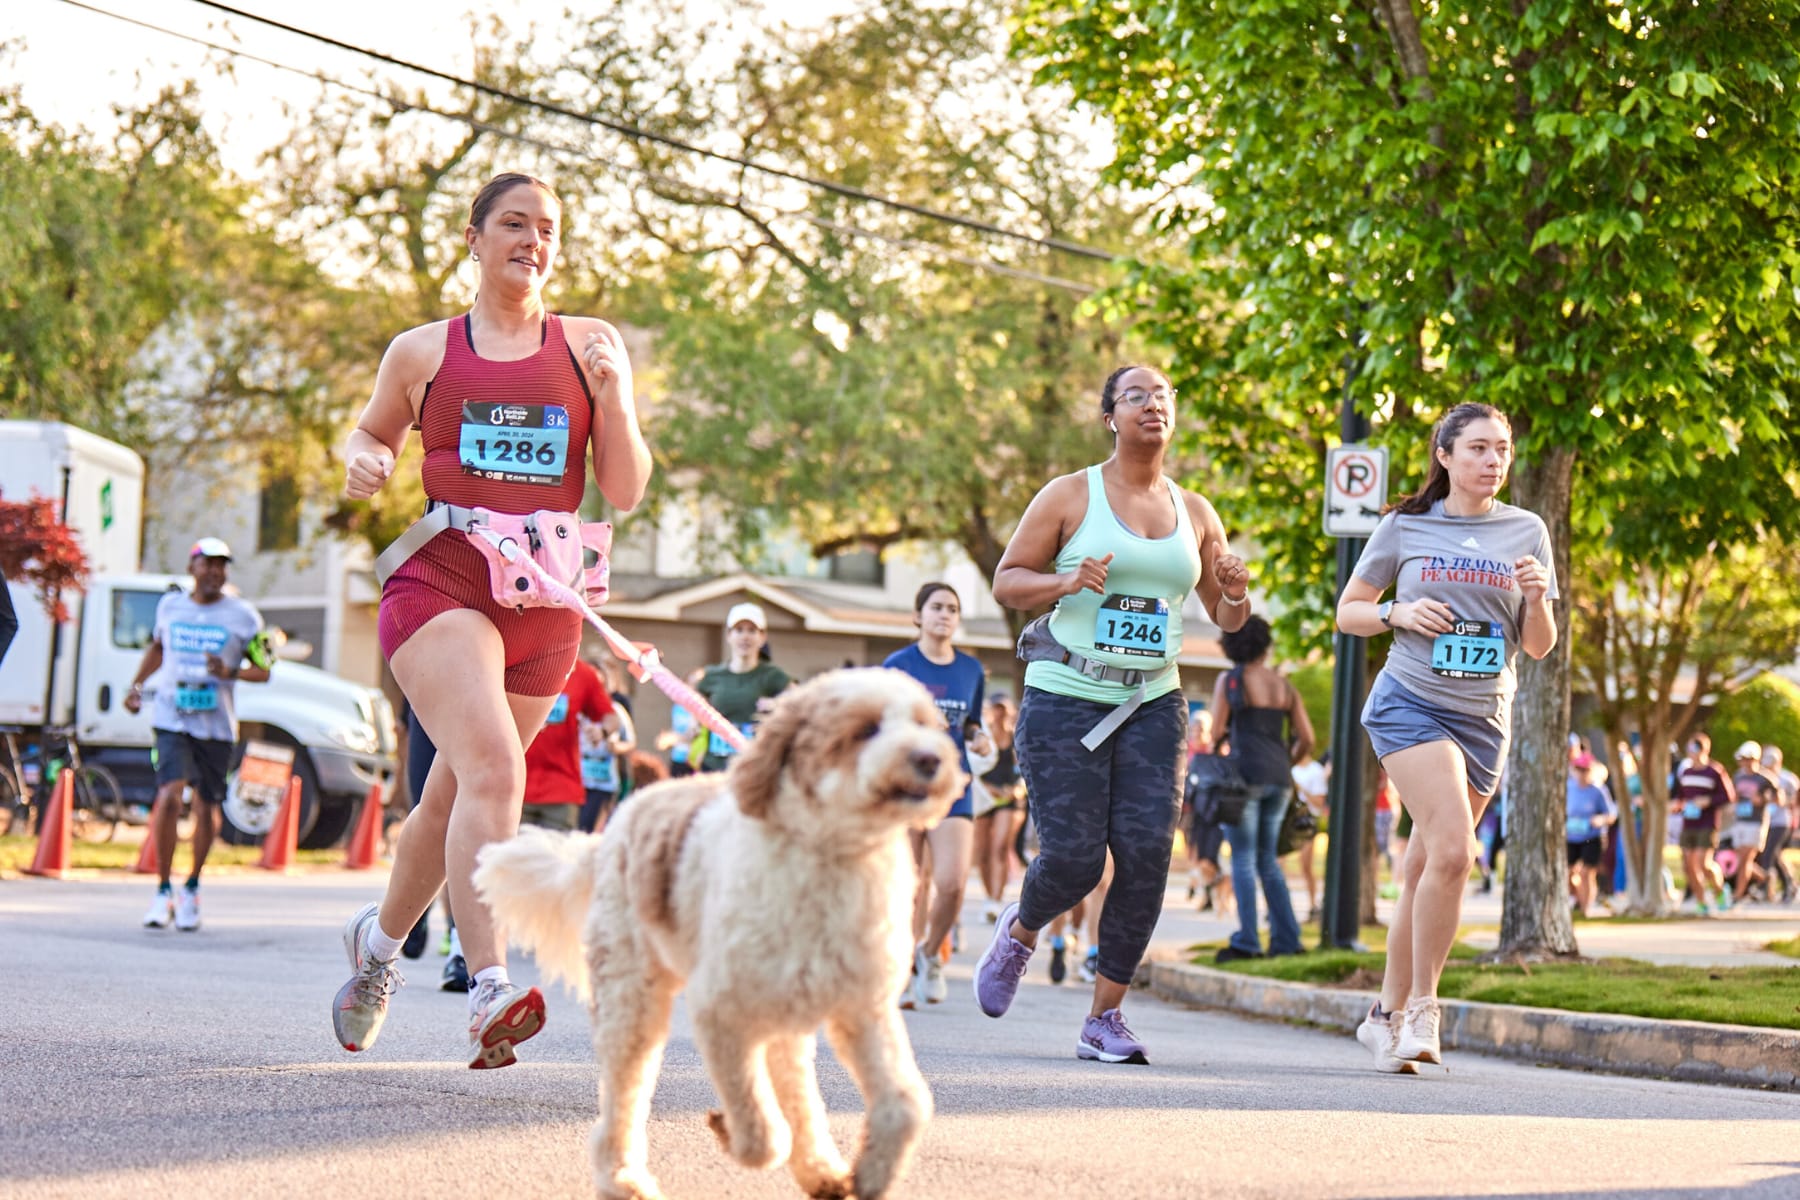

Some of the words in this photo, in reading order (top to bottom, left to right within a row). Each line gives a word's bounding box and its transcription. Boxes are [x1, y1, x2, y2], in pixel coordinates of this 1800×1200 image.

[547, 414, 565, 426] 3K
[475, 439, 556, 466] 1286
[1431, 556, 1445, 566] IN
[1421, 569, 1514, 592] PEACHTREE
[1108, 619, 1162, 644] 1246
[1444, 644, 1498, 666] 1172
